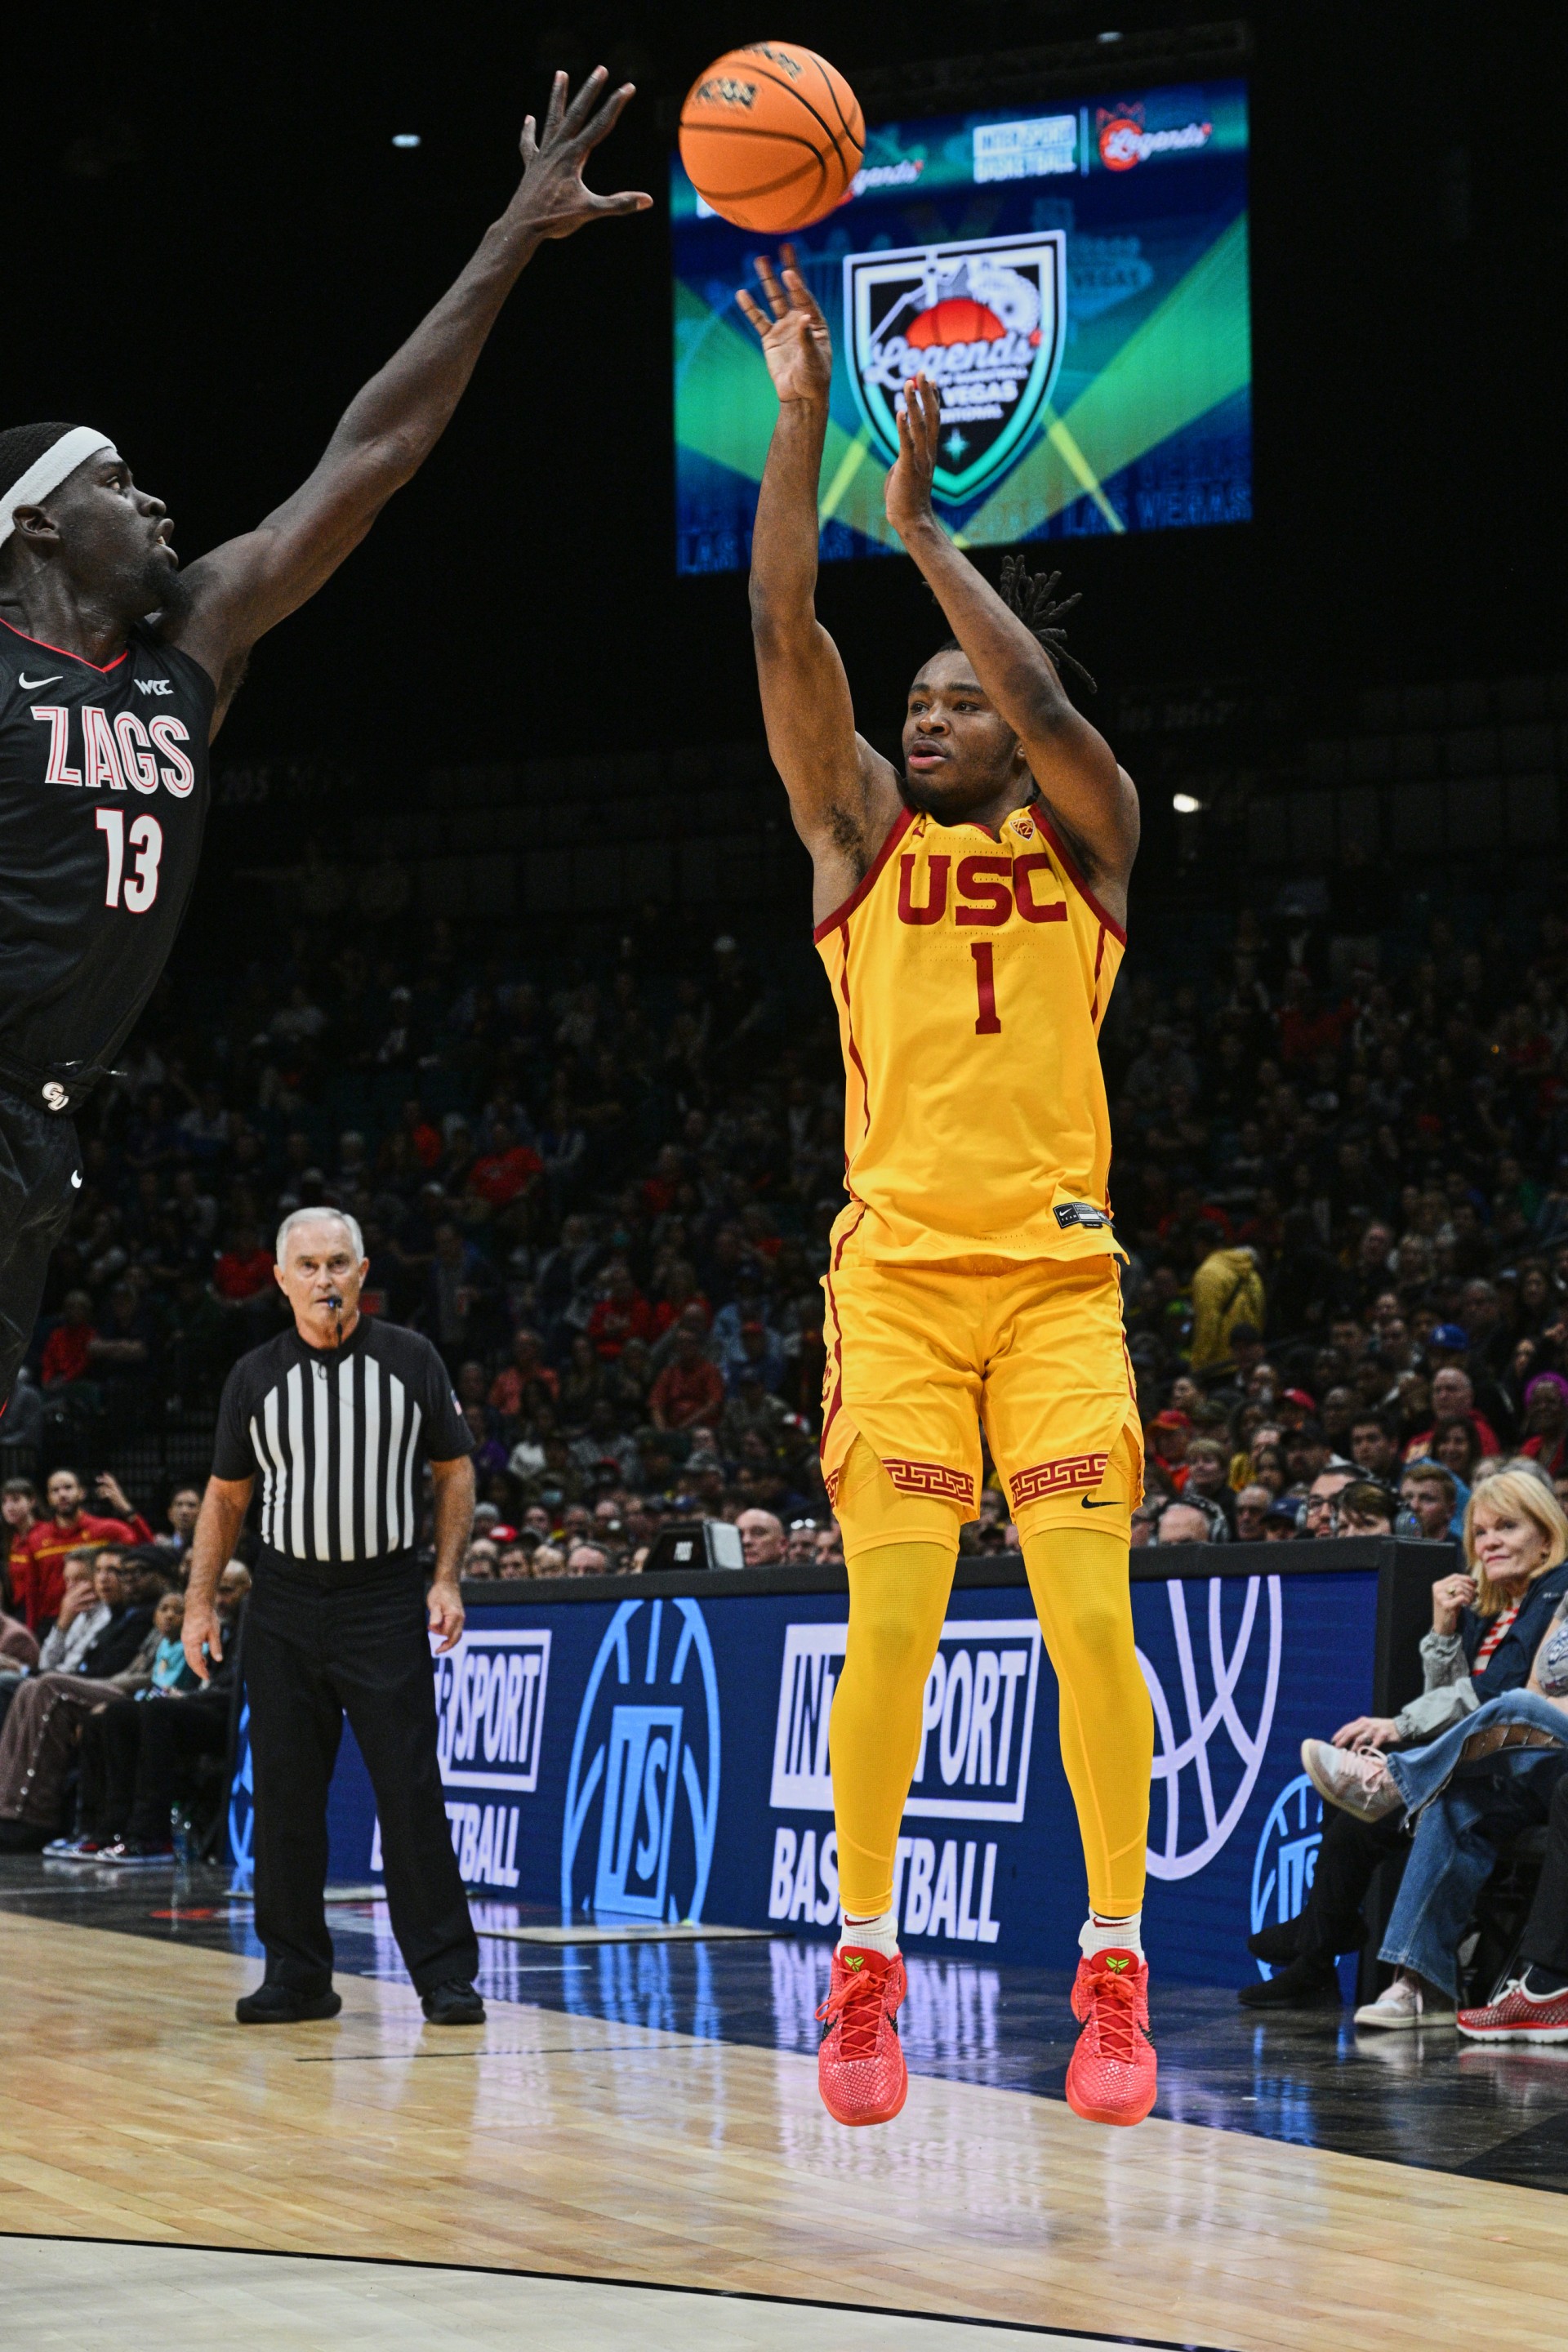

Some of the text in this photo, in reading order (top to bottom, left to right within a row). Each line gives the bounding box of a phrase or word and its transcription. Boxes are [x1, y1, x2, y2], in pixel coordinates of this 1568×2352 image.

[862, 331, 1032, 390] Legends
[942, 379, 1018, 408] VEGAS
[133, 679, 174, 696] WCC
[30, 706, 194, 798] ZAGS
[96, 807, 163, 913] 13
[898, 853, 1068, 927] USC
[971, 942, 1001, 1035] 1
[768, 1827, 1000, 1943] BASTBALL
